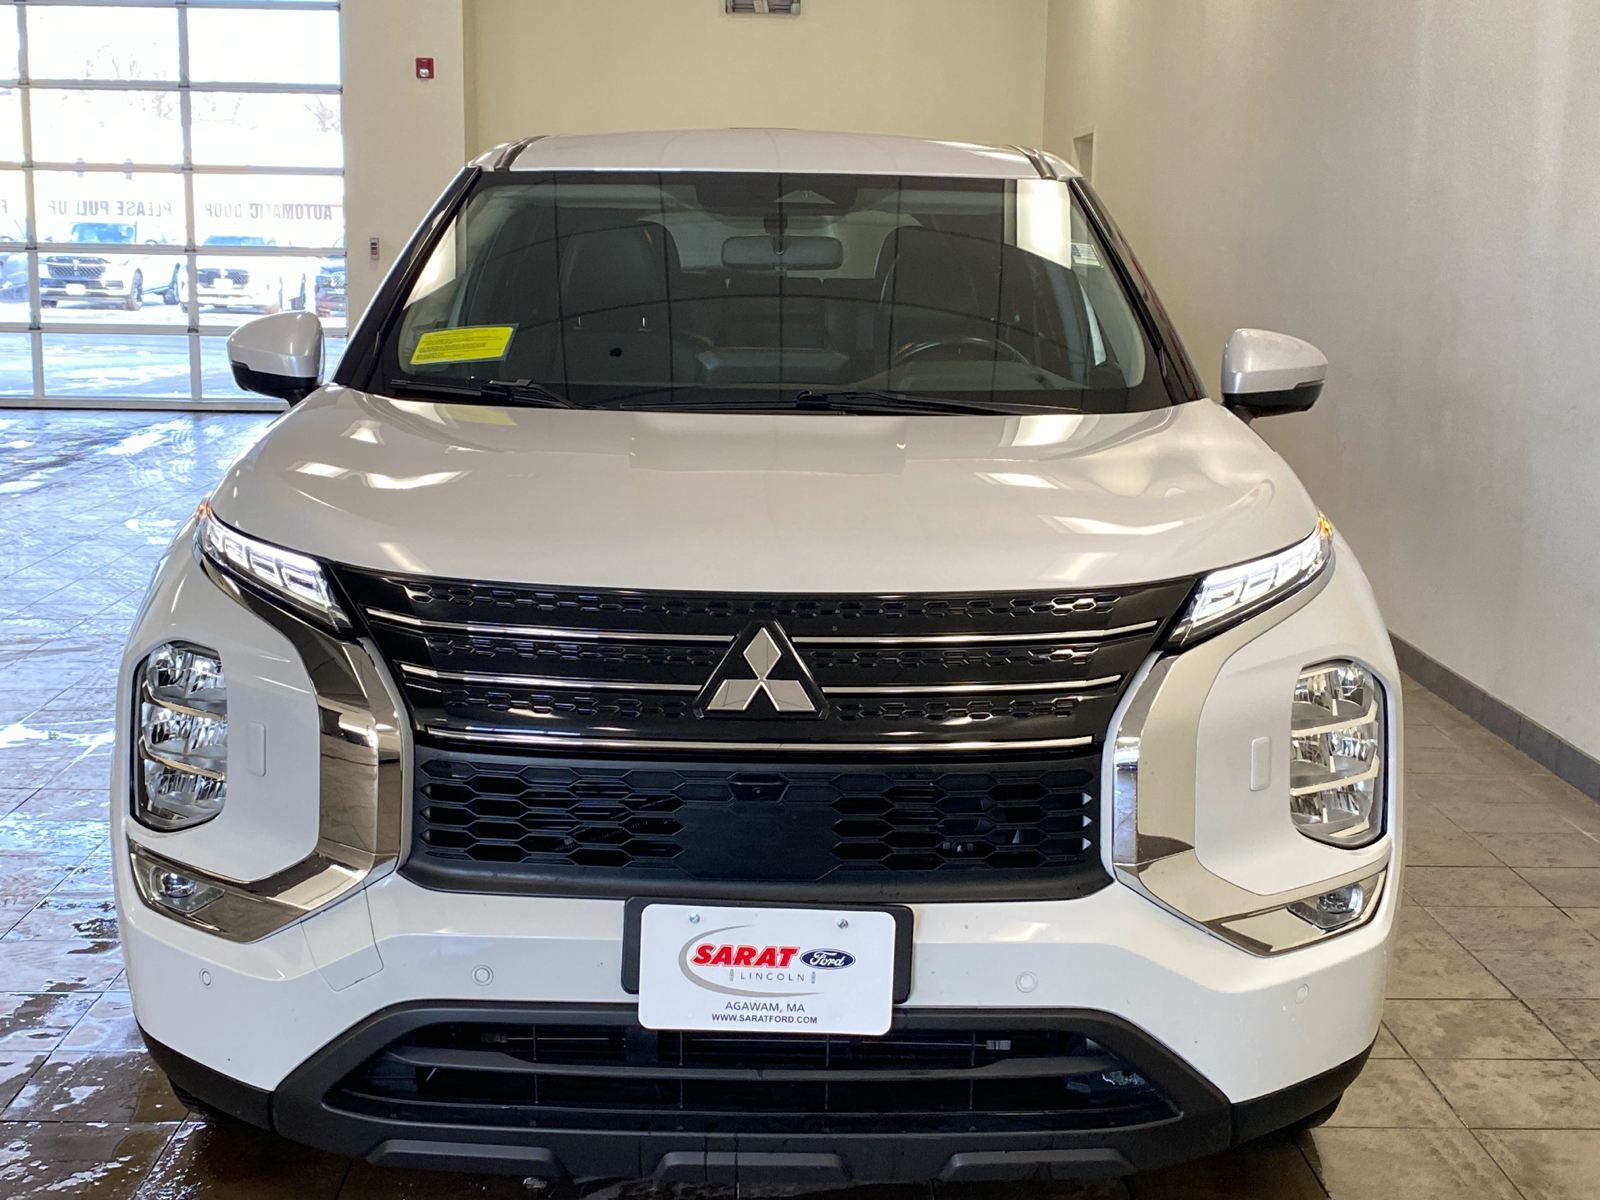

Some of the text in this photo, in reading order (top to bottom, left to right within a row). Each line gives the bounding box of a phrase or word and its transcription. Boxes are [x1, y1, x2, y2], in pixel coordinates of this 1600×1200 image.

[691, 943, 800, 968] SARAT
[740, 971, 805, 983] LINCOLN
[725, 1001, 805, 1013] AGAWAM, MA
[711, 1013, 818, 1025] WWW.SARATFORD.COM
